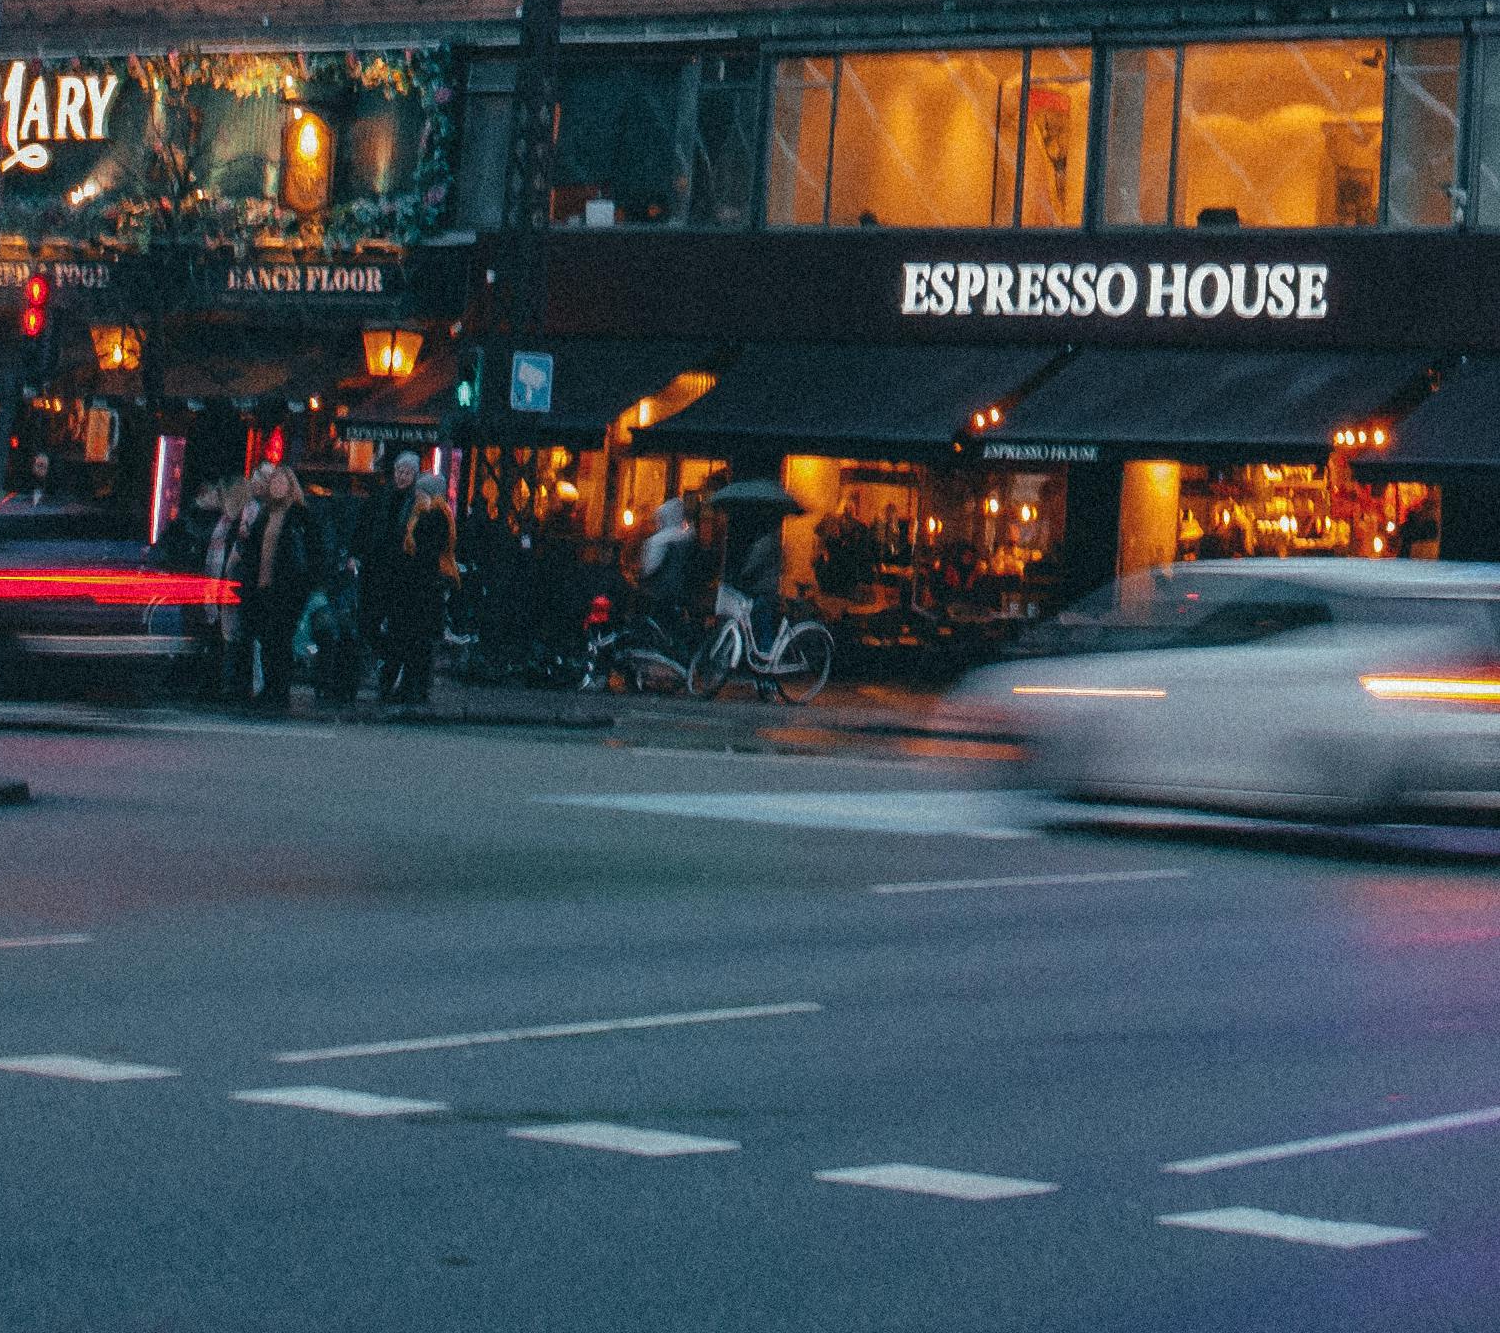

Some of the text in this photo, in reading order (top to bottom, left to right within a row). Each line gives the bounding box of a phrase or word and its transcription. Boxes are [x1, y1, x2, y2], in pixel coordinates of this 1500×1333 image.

[306, 267, 382, 292] FLOOR
[902, 262, 1328, 319] ESPRESSO HOUSE
